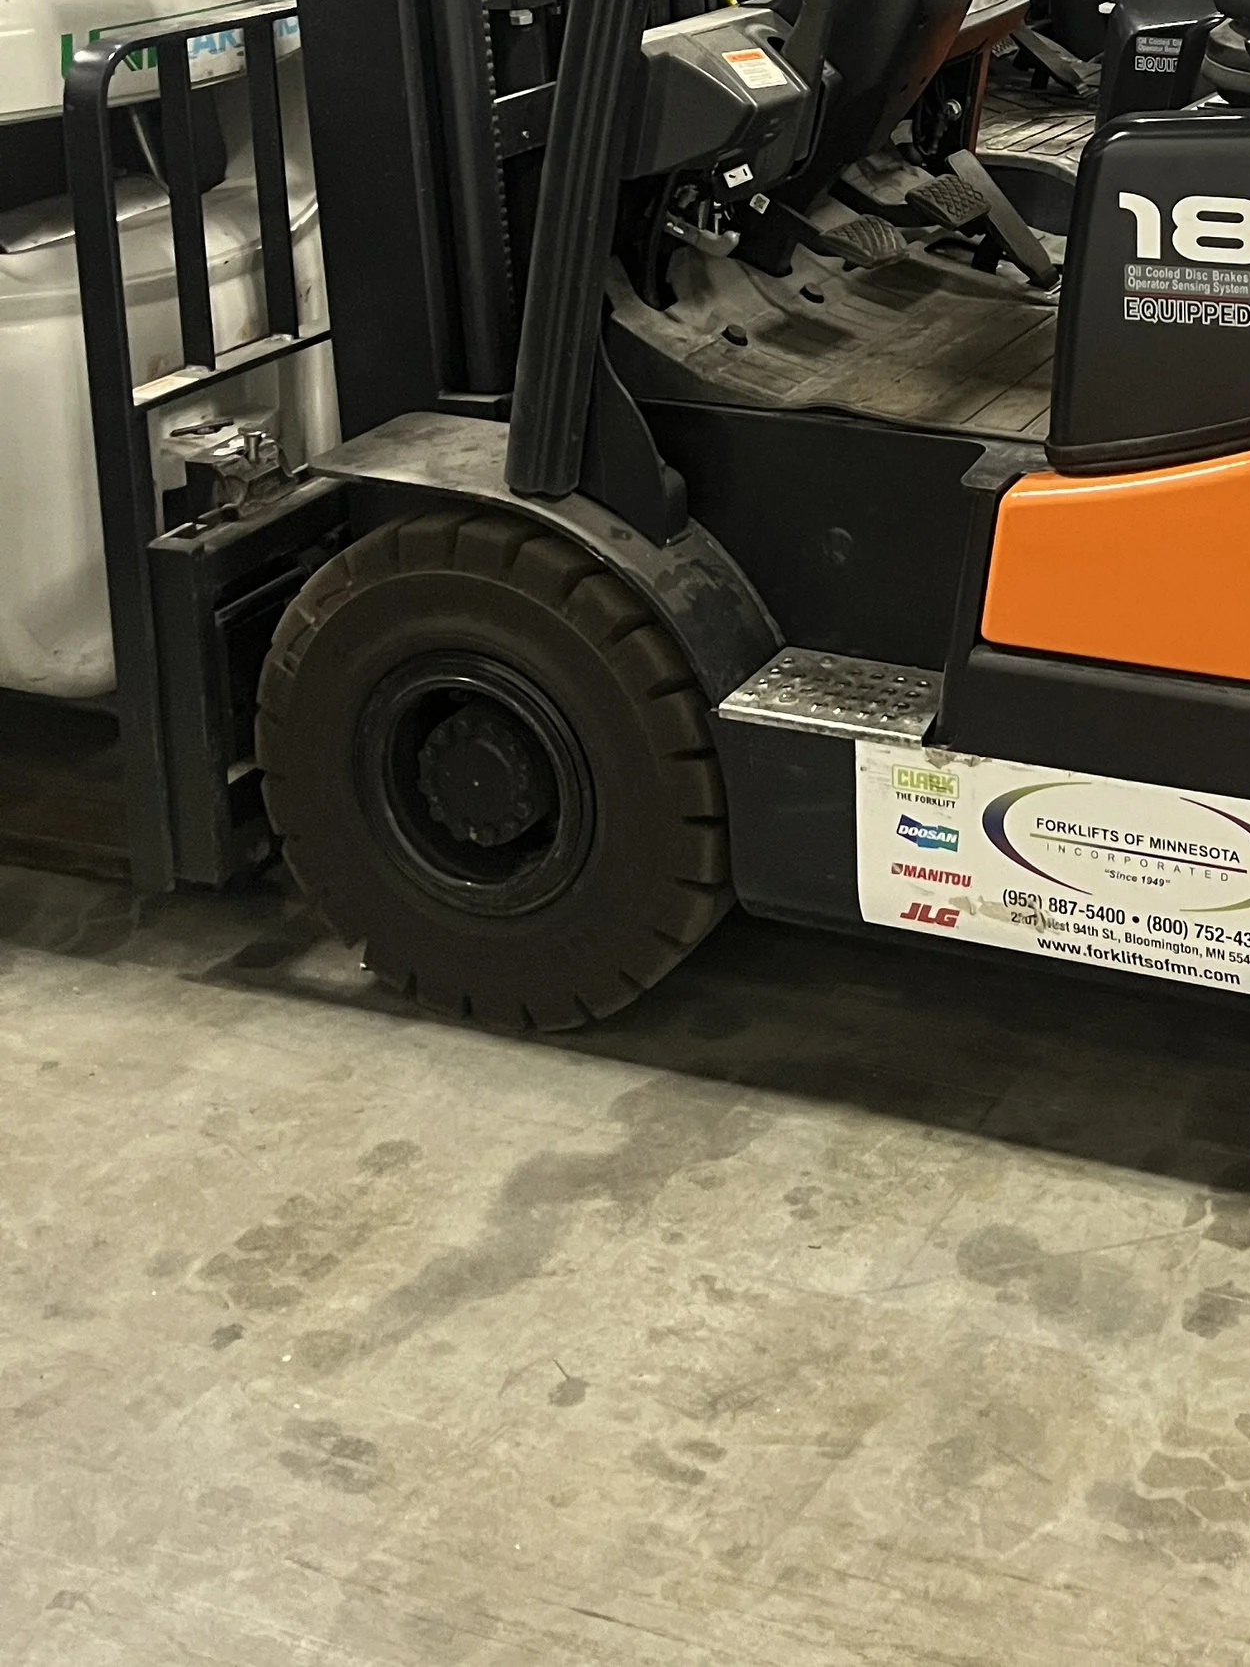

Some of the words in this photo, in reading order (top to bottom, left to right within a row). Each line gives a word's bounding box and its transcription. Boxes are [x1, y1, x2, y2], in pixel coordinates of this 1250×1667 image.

[1128, 265, 1141, 277] Oil
[1146, 267, 1180, 279] Cooled
[1185, 269, 1208, 281] Disc
[1213, 270, 1249, 283] Brakes
[1128, 277, 1169, 290] Operator
[1172, 279, 1211, 294] Sensing
[1213, 282, 1249, 296] System
[897, 768, 956, 795] CLARK
[896, 792, 912, 802] THE
[915, 795, 956, 809] FORKLIFT
[898, 824, 958, 845] DOOSAN
[1036, 817, 1119, 843] FORKLIFTS
[1124, 833, 1145, 846] OF
[1149, 837, 1240, 863] MINNESOTA
[1046, 842, 1229, 882] INCORPORATED
[903, 865, 972, 888] MANITOU
[900, 902, 960, 928] JLG
[1048, 897, 1126, 925] 887-5400
[1146, 914, 1188, 940] (800)
[1073, 922, 1099, 937] 94th
[1125, 932, 1203, 958] Bloomington,
[1206, 946, 1225, 960] MN
[1037, 937, 1240, 985] www.forkliftsofmn.com
